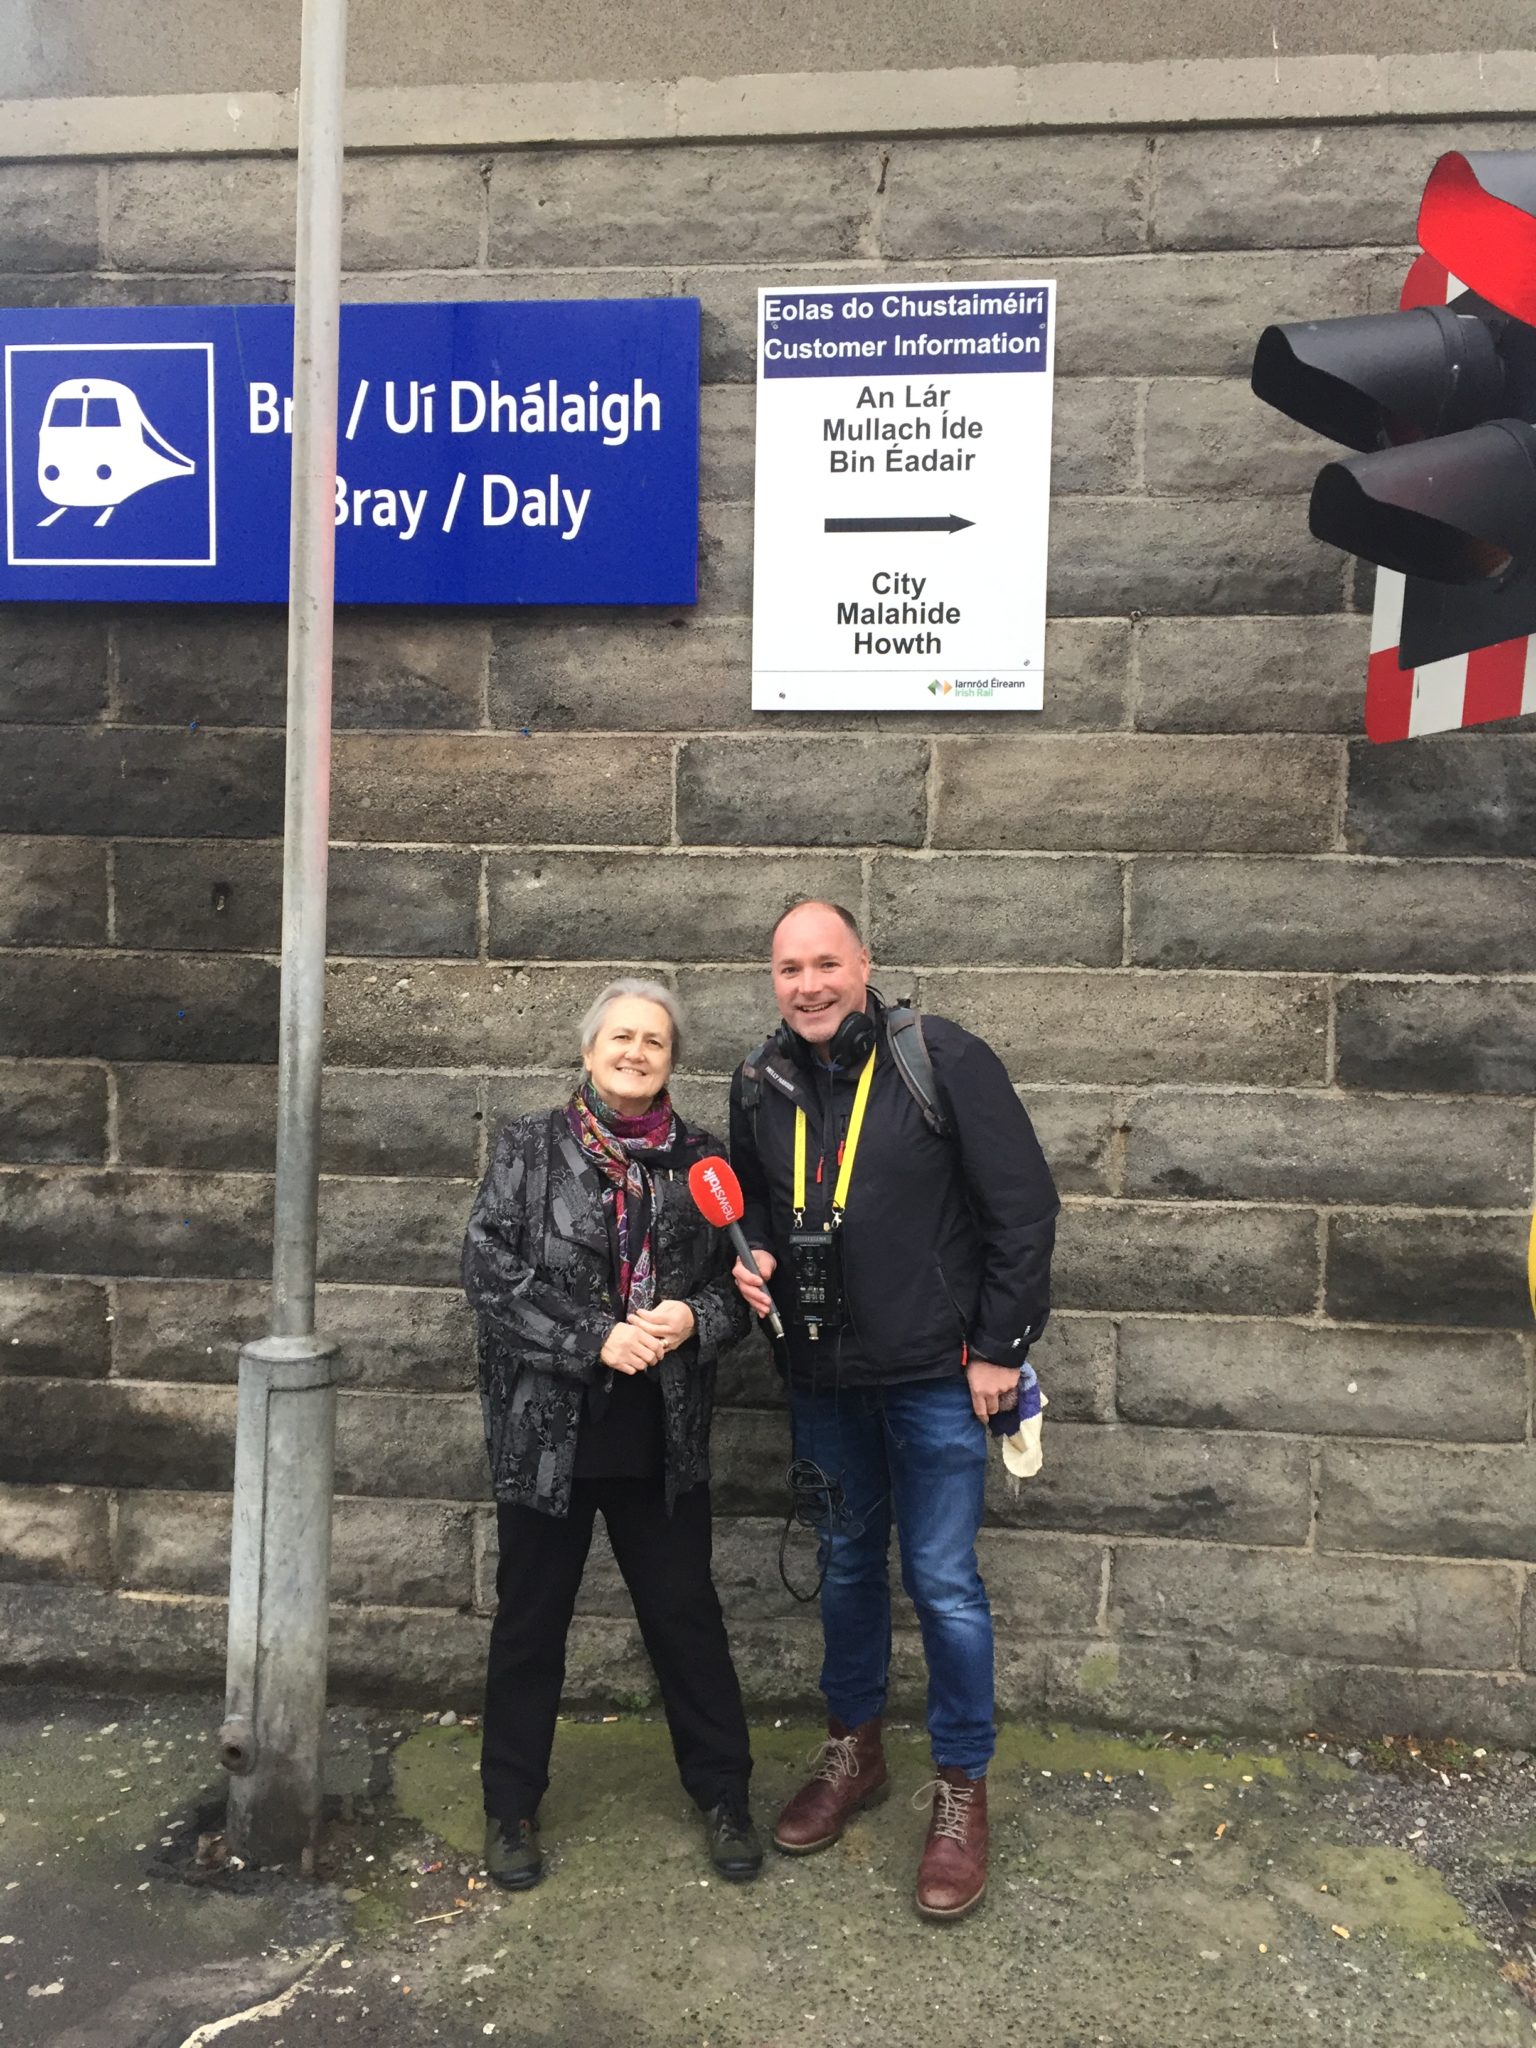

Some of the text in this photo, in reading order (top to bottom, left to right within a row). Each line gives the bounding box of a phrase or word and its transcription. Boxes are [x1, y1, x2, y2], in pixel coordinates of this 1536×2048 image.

[764, 291, 1044, 322] Eolas do Chustaiméirí
[764, 333, 1041, 360] Customer Information
[856, 383, 951, 409] An Lár
[249, 378, 661, 446] Br / Uí Dhálaigh
[823, 409, 983, 442] Mullach Íde
[830, 442, 976, 473] Bin Éadair
[442, 472, 467, 533] /
[482, 473, 592, 541] Daly
[872, 571, 927, 601] City
[837, 601, 962, 625] Malahide
[854, 631, 942, 655] Howth
[954, 688, 993, 697] Irish Rail
[955, 677, 1025, 688] Iarnród Éireann
[702, 1166, 736, 1222] newstalk
